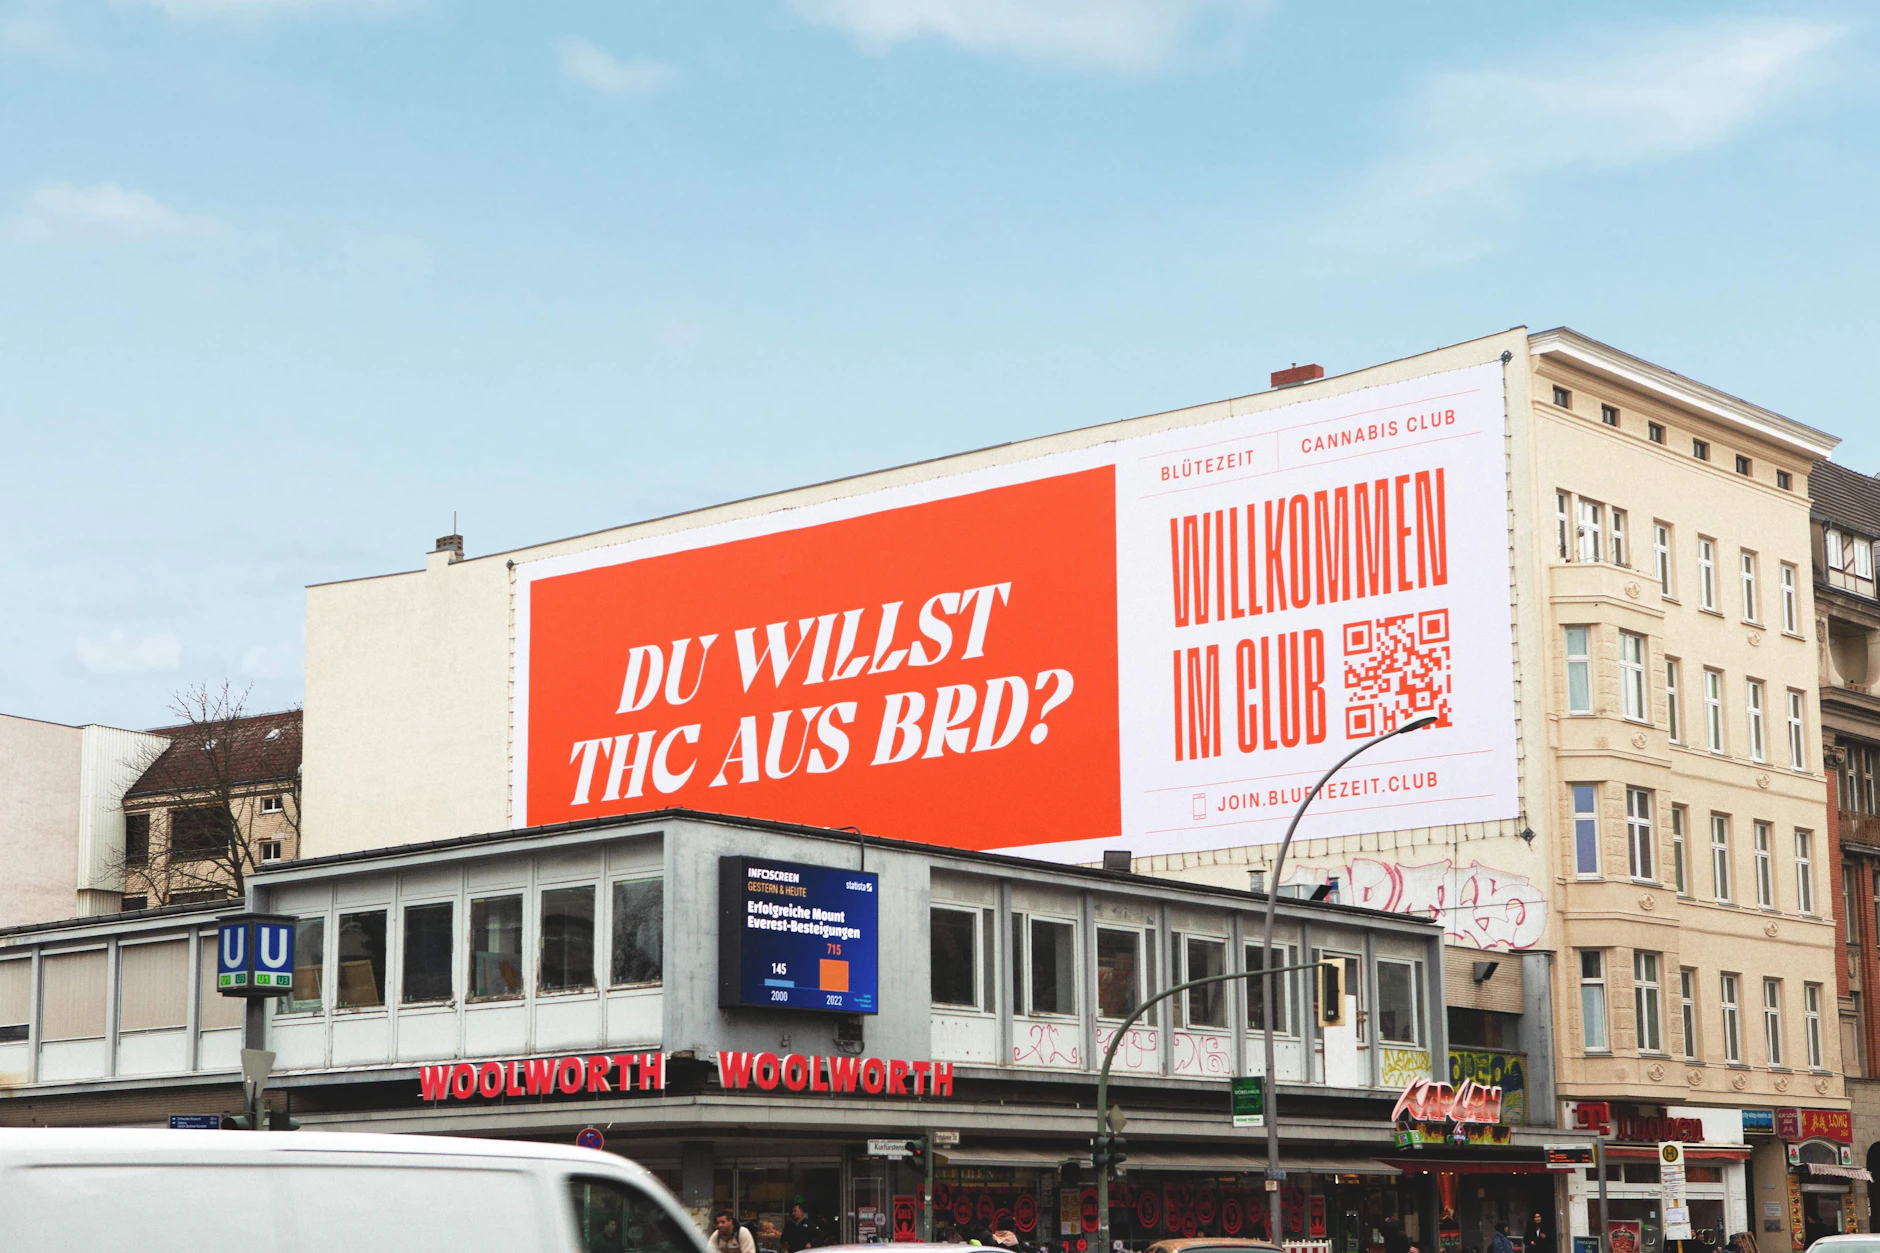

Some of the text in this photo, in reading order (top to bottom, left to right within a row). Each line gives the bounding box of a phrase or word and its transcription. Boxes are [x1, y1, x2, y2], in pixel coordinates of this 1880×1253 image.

[1301, 409, 1456, 454] CANNABIS CLUB
[1161, 450, 1254, 482] BLÜTEZEIT
[1170, 467, 1448, 628] WILLKOMMEN
[616, 582, 1012, 714] DU WILLST
[1173, 629, 1327, 762] IM CLUB
[569, 669, 1074, 806] THC AUS BRD?
[1218, 771, 1438, 812] JOIN.BLUETEZEIT.CLUB
[748, 868, 800, 883] INFOSCREEN
[748, 881, 807, 898] GESTERN & HEUTE
[846, 881, 866, 891] statista
[748, 900, 845, 923] Erfolgreiche Mount
[748, 915, 861, 940] Everest-Besteigungen
[223, 927, 244, 969] U
[260, 926, 288, 969] U
[826, 943, 842, 956] 715
[236, 974, 245, 984] U3
[258, 975, 289, 985] U1 U3
[771, 963, 787, 975] 145
[771, 990, 788, 1002] 2000
[826, 995, 843, 1006] 2022
[418, 1052, 667, 1101] WOOLWORTH
[715, 1050, 954, 1097] WOOLWORTH
[1391, 1076, 1503, 1123] KAPLAN
[1829, 1114, 1848, 1128] LONG
